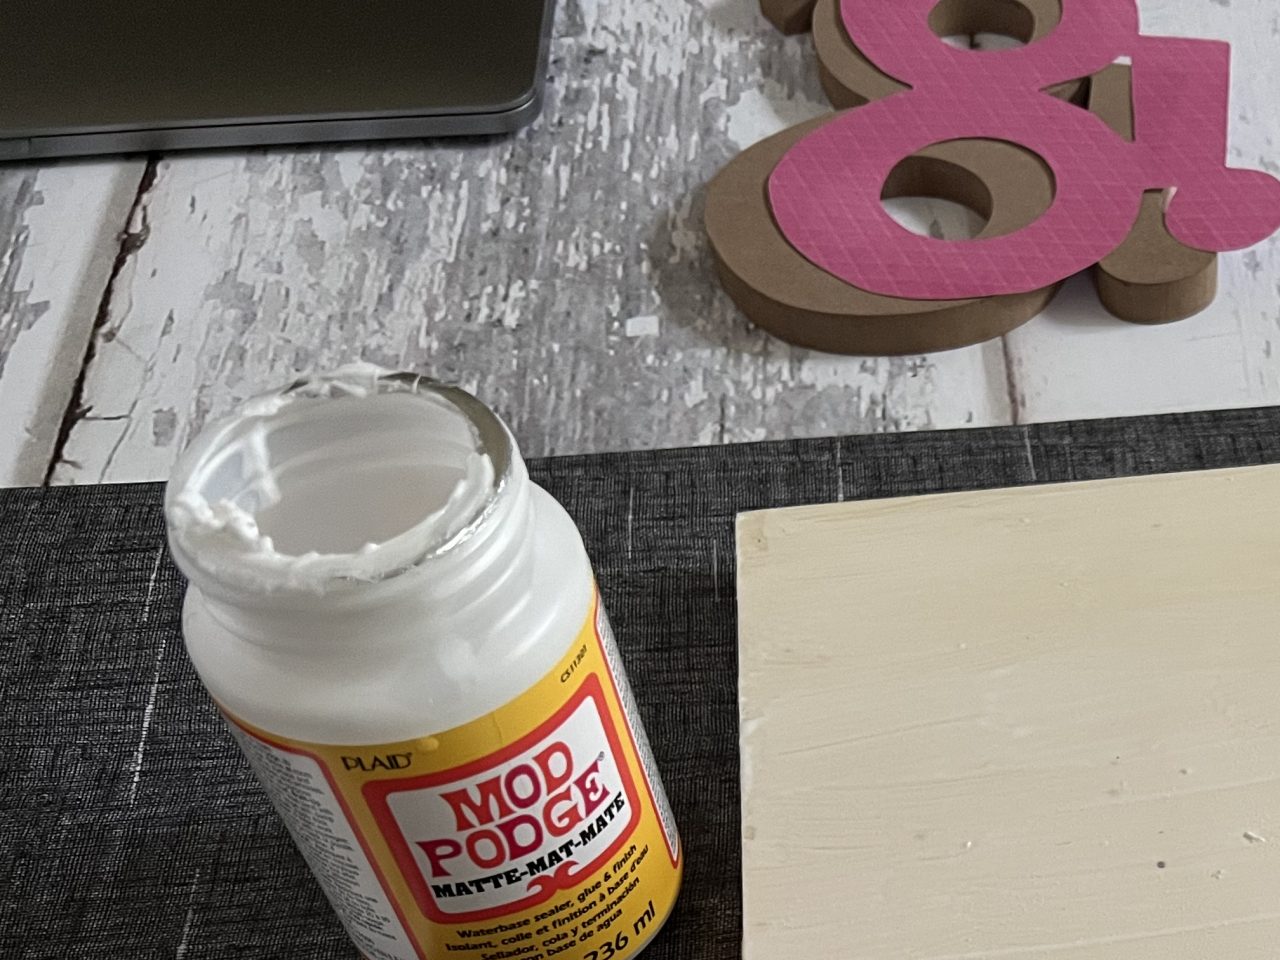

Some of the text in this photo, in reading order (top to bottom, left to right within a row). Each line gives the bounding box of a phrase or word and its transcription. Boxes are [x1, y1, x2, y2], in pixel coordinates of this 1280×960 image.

[341, 753, 411, 771] PLAID
[438, 741, 573, 832] MOD
[415, 760, 610, 878] PODGE
[430, 791, 625, 898] MATTE-MAT-MATE
[456, 844, 637, 938] Waterbase sealer, glue & finish
[481, 876, 640, 960] Sellador, cola y terminación
[501, 932, 533, 945] colle
[536, 925, 549, 935] et
[551, 900, 597, 929] finition
[607, 872, 629, 895] base
[546, 939, 576, 956] base
[579, 930, 594, 942] de
[596, 908, 623, 932] agua
[633, 900, 656, 936] ml
